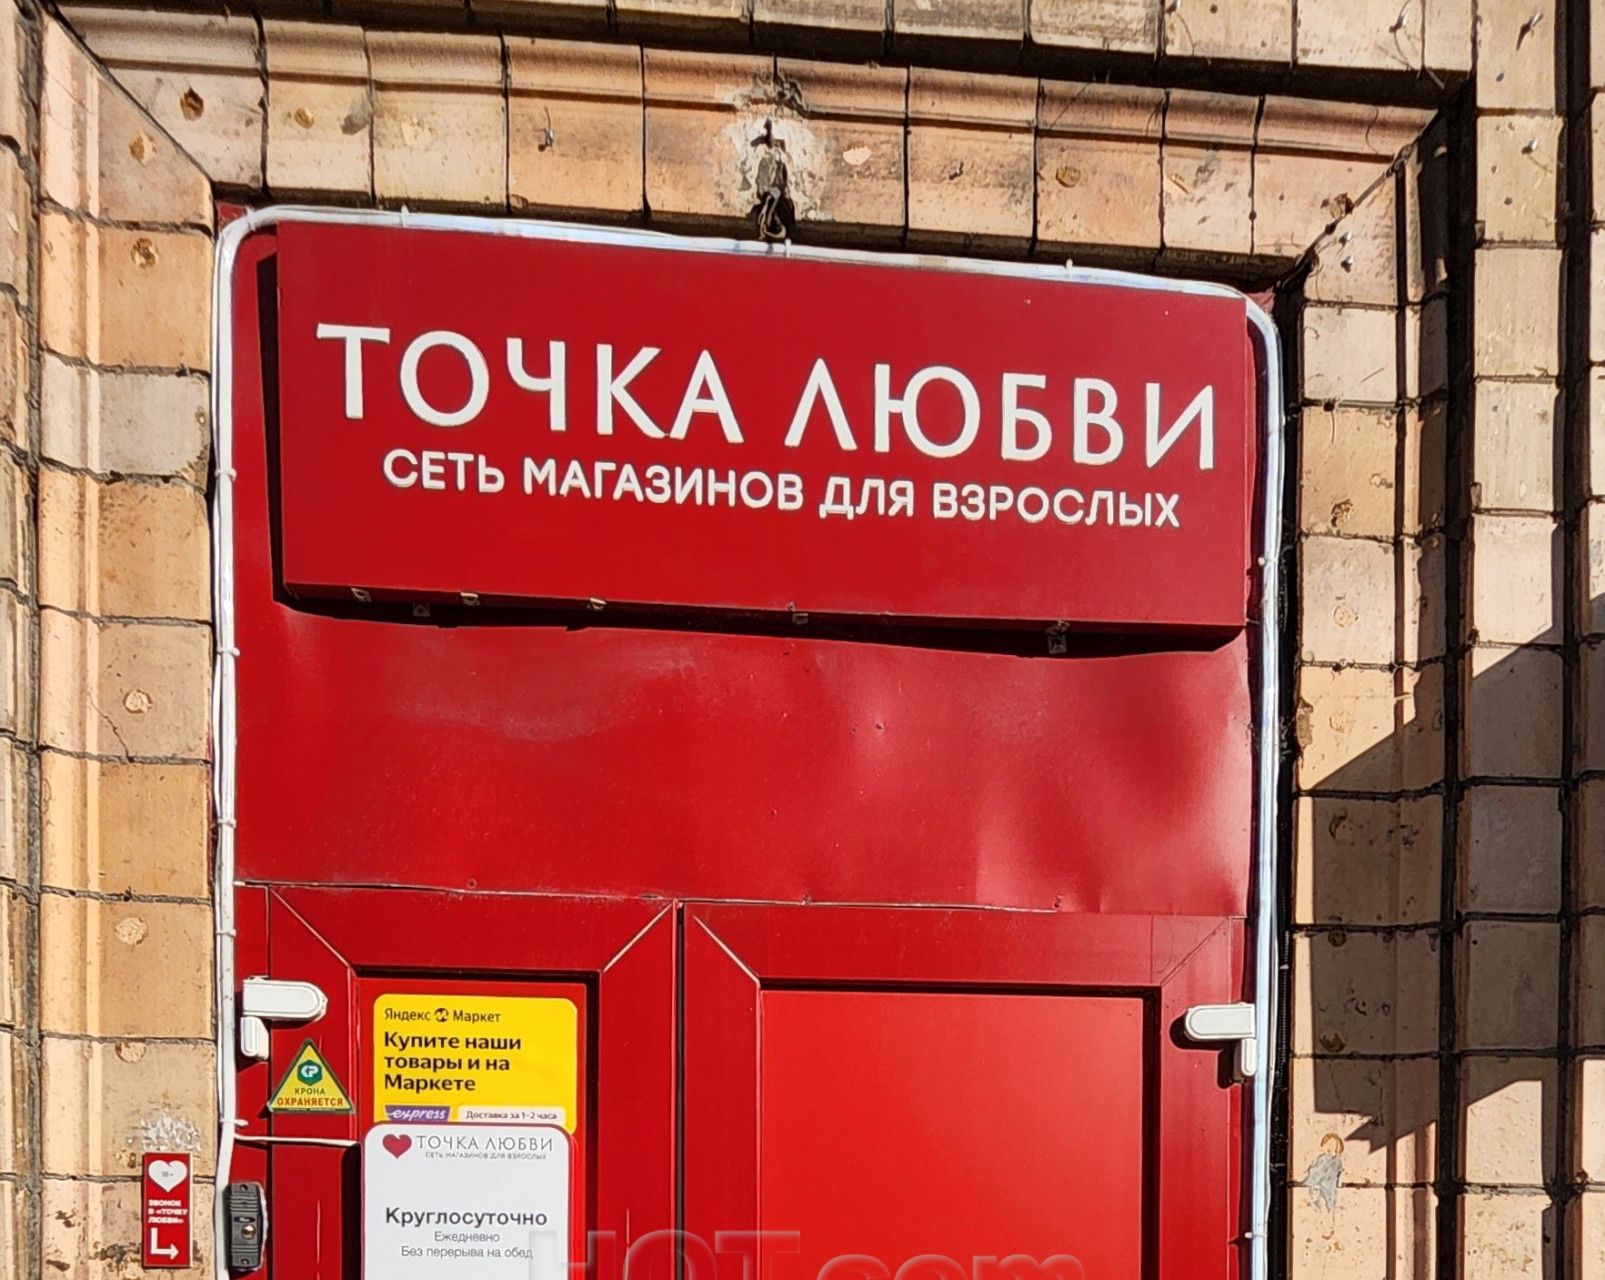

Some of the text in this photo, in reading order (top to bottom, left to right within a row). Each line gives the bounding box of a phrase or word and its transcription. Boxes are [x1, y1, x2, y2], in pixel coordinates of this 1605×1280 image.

[317, 323, 1214, 471] ТОЧКА ЛЮБВИ
[383, 448, 1180, 528] СЕТЬ МАГАЗИНОВ ДЛЯ ВЗРОСЛЫХ
[384, 1007, 501, 1024] Яндекс Маркет
[384, 1031, 522, 1052] Купите наши
[384, 1055, 511, 1073] товары и на
[294, 1086, 326, 1096] КРОНА
[384, 1073, 477, 1094] Маркете
[276, 1096, 344, 1107] ОХРАНЯЕТСЯ
[389, 1108, 447, 1122] express
[465, 1110, 508, 1120] Доставка
[510, 1112, 519, 1120] за
[537, 1112, 558, 1120] часа
[416, 1135, 554, 1152] ТОЧКА ЛЮБВИ
[424, 1151, 547, 1161] СЕТЬ МАГАЗИНОВ ДЛЯ ВЗРОСЛЫХ
[385, 1207, 547, 1229] Круглосуточно
[434, 1230, 501, 1244] Ежедневно
[401, 1246, 534, 1260] Без перерыва на обед
